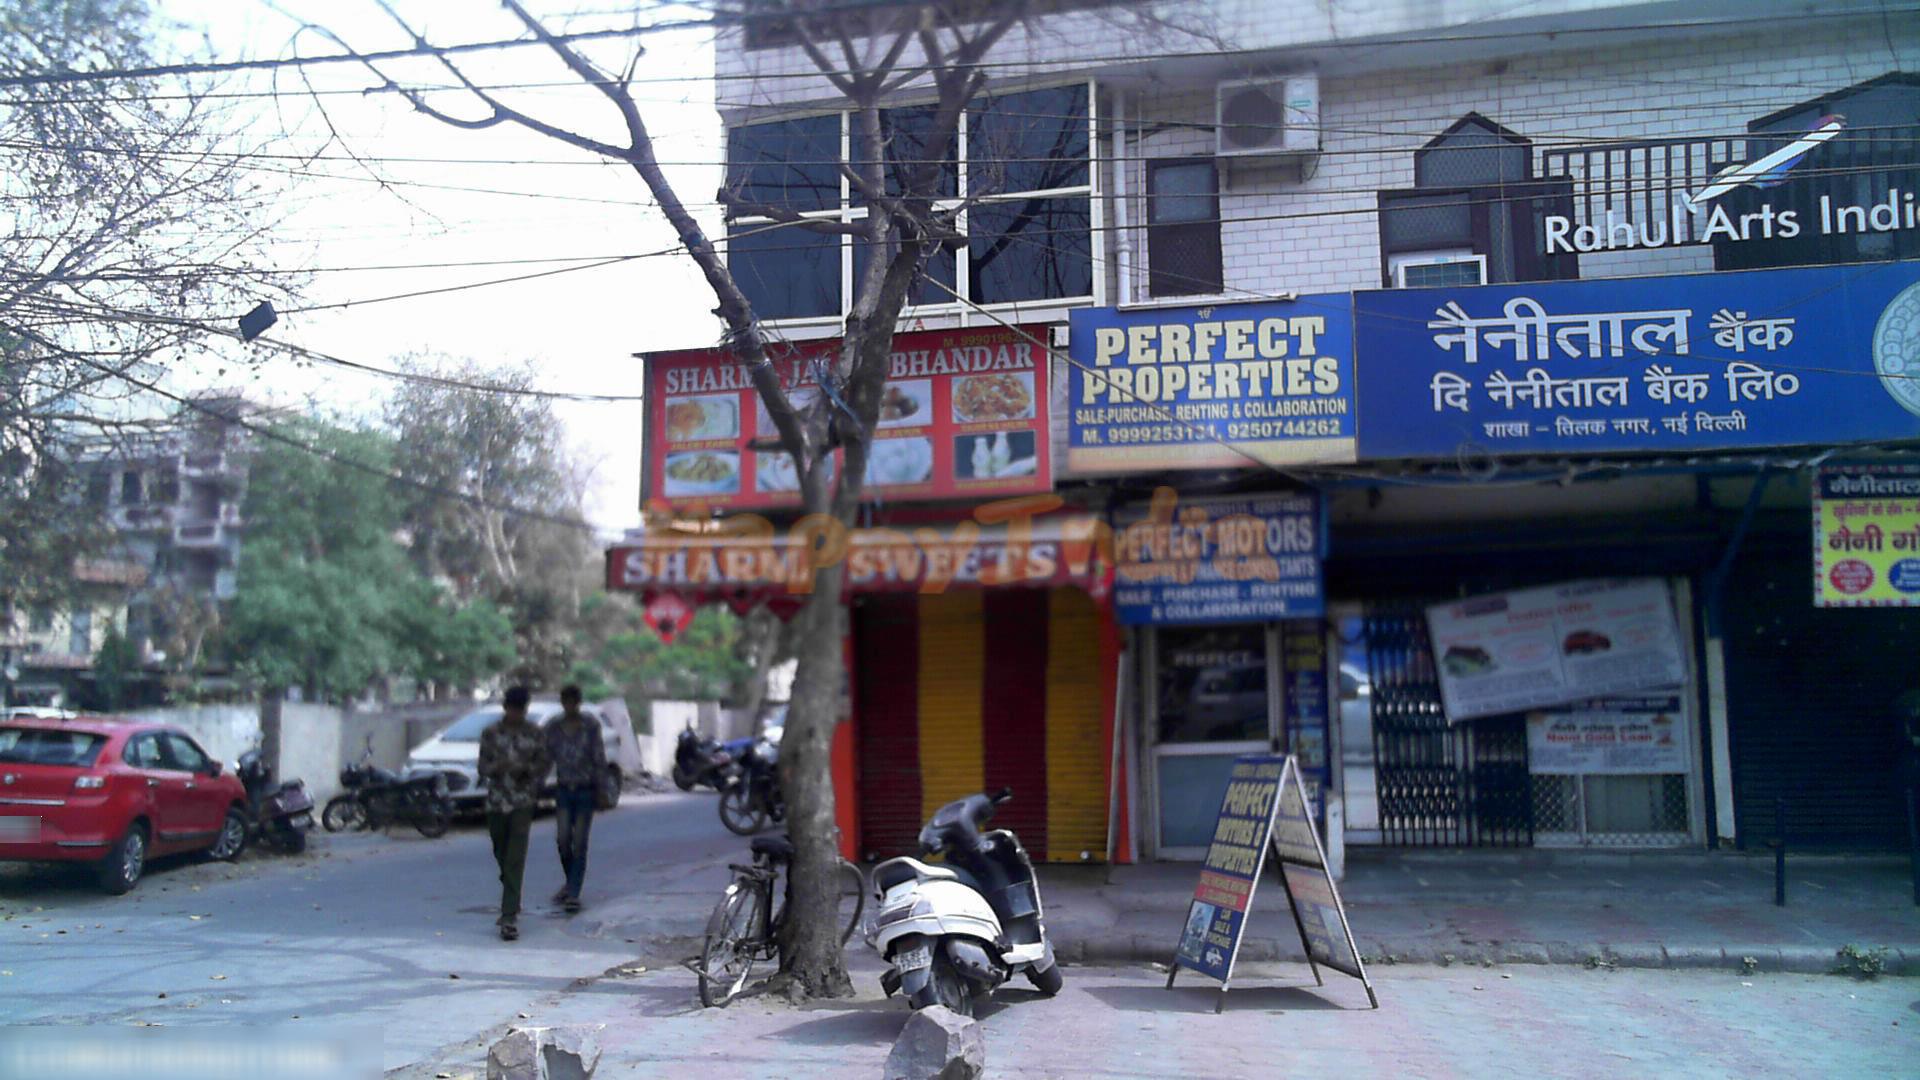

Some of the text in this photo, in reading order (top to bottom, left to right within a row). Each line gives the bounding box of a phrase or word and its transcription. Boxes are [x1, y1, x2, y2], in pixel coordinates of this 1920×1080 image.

[1545, 188, 1920, 254] Rahul Arts Indi
[1095, 316, 1325, 367] PERFECT
[1427, 296, 1796, 363] नैनीताल बैंक
[891, 343, 1035, 378] BHANDAR
[1082, 357, 1340, 405] PROPERTIES
[1430, 371, 1472, 412] दि
[1485, 369, 1629, 410] नैनीताल
[1643, 363, 1710, 405] बैंक
[1175, 402, 1229, 421] RENTING
[1232, 404, 1241, 418] &
[1244, 398, 1347, 419] COLLABORATION
[1228, 419, 1341, 440] 9250744262
[1484, 421, 1529, 438] शाखा
[1555, 416, 1607, 437] तिलक
[1661, 411, 1688, 435] नई
[1694, 410, 1747, 432] दिल्ली
[1113, 516, 1314, 560] PERFECT MOTORS
[848, 544, 1058, 584] SWEETS
[1165, 600, 1286, 618] COLLABORATION
[1222, 783, 1276, 817] PERFECT
